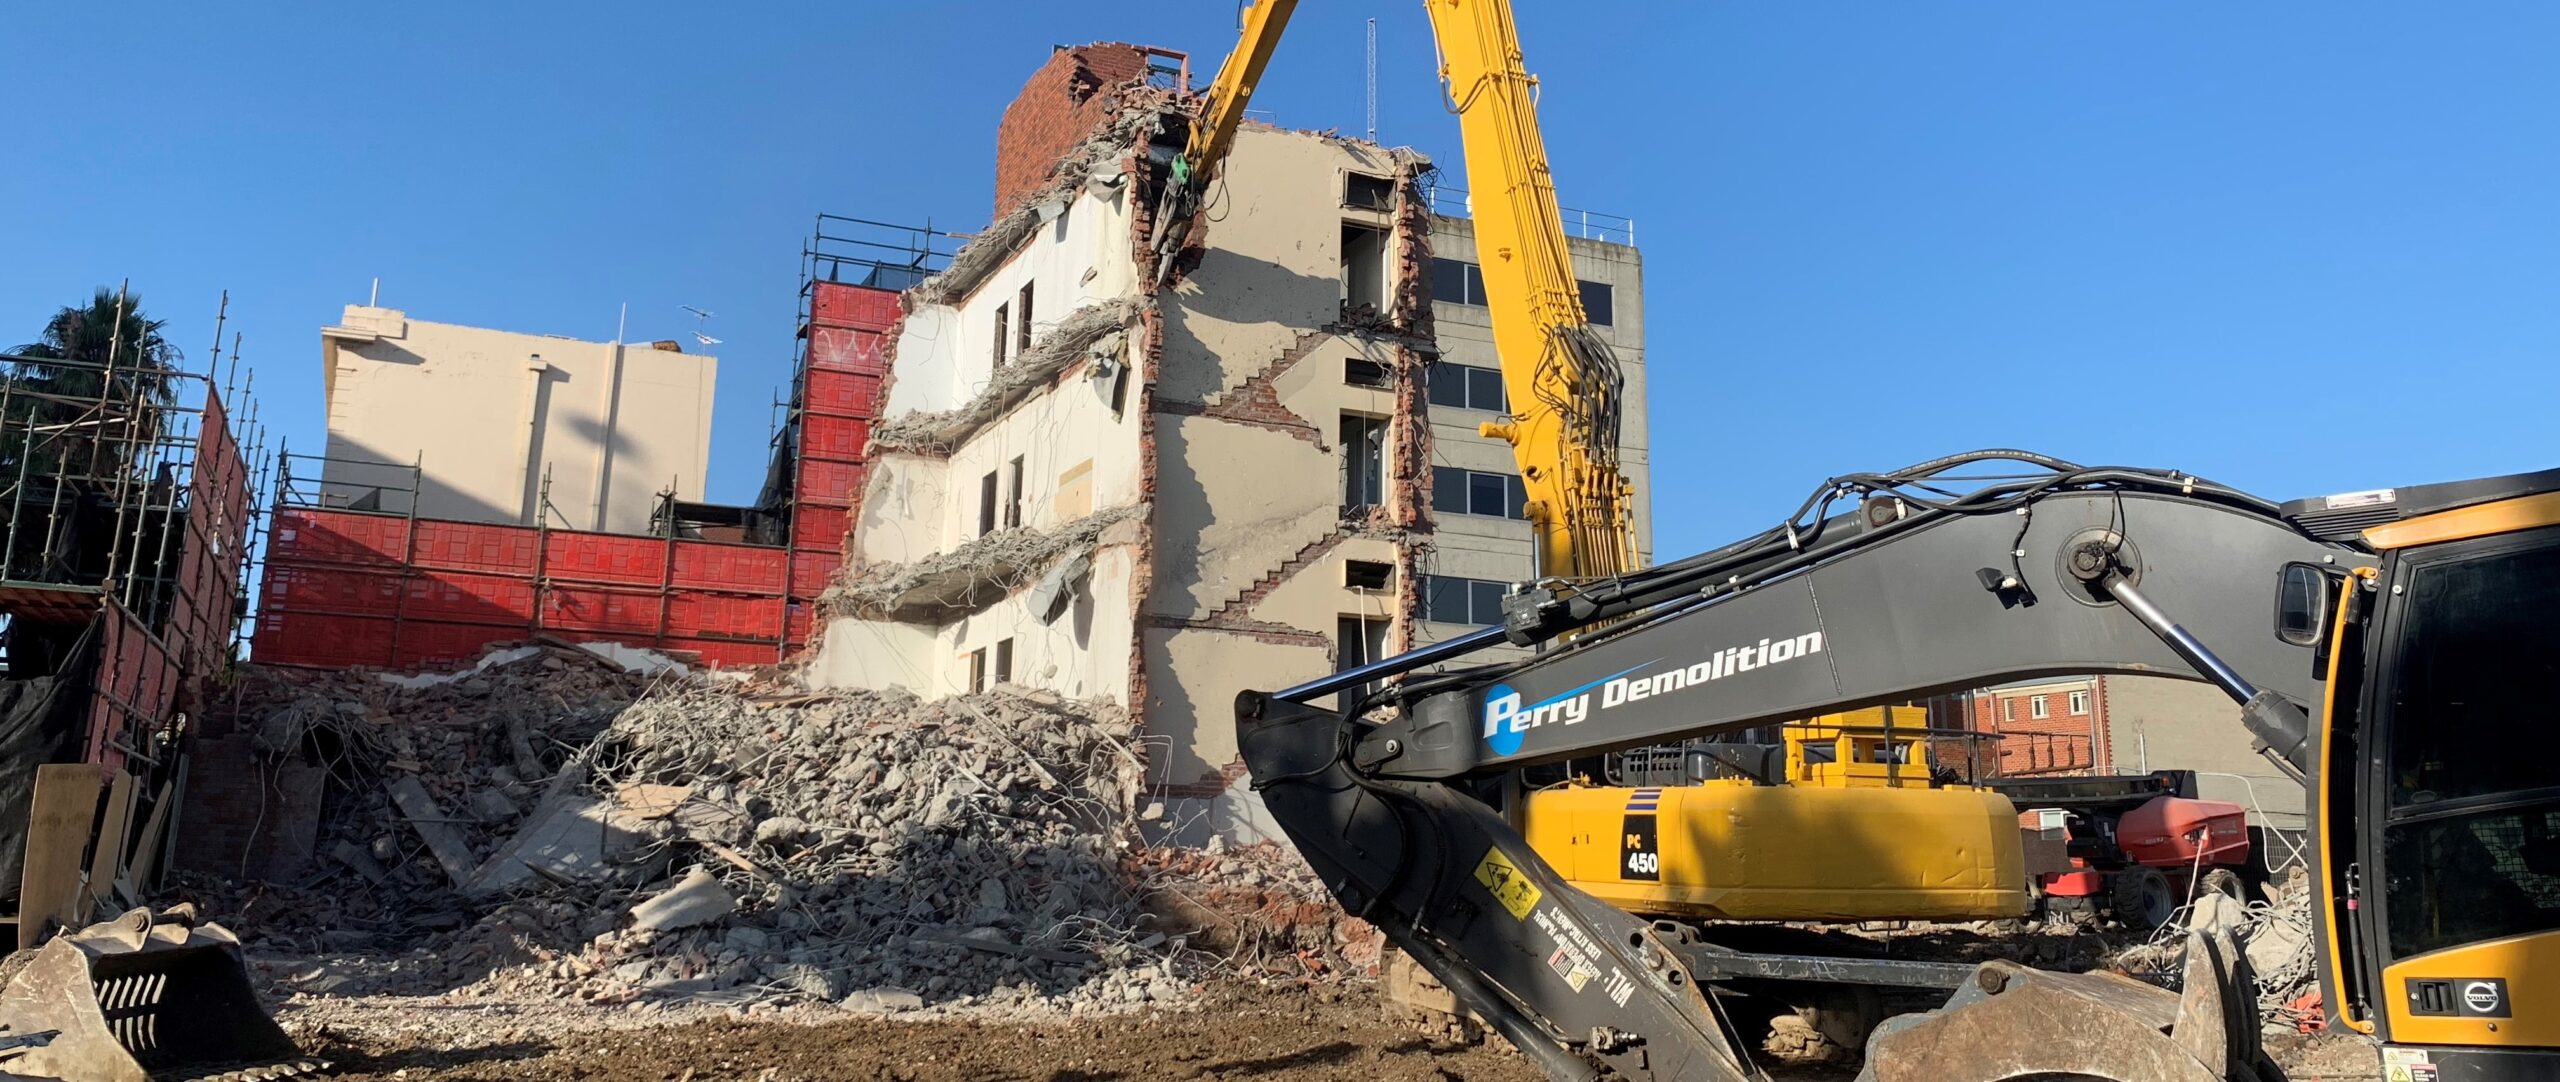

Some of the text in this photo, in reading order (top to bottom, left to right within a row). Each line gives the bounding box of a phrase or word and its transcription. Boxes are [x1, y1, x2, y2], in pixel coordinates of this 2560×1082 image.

[1483, 631, 1822, 738] Perry Demolition
[1627, 834, 1641, 849] PC
[1628, 852, 1658, 873] 450
[1585, 941, 1602, 961] LESS
